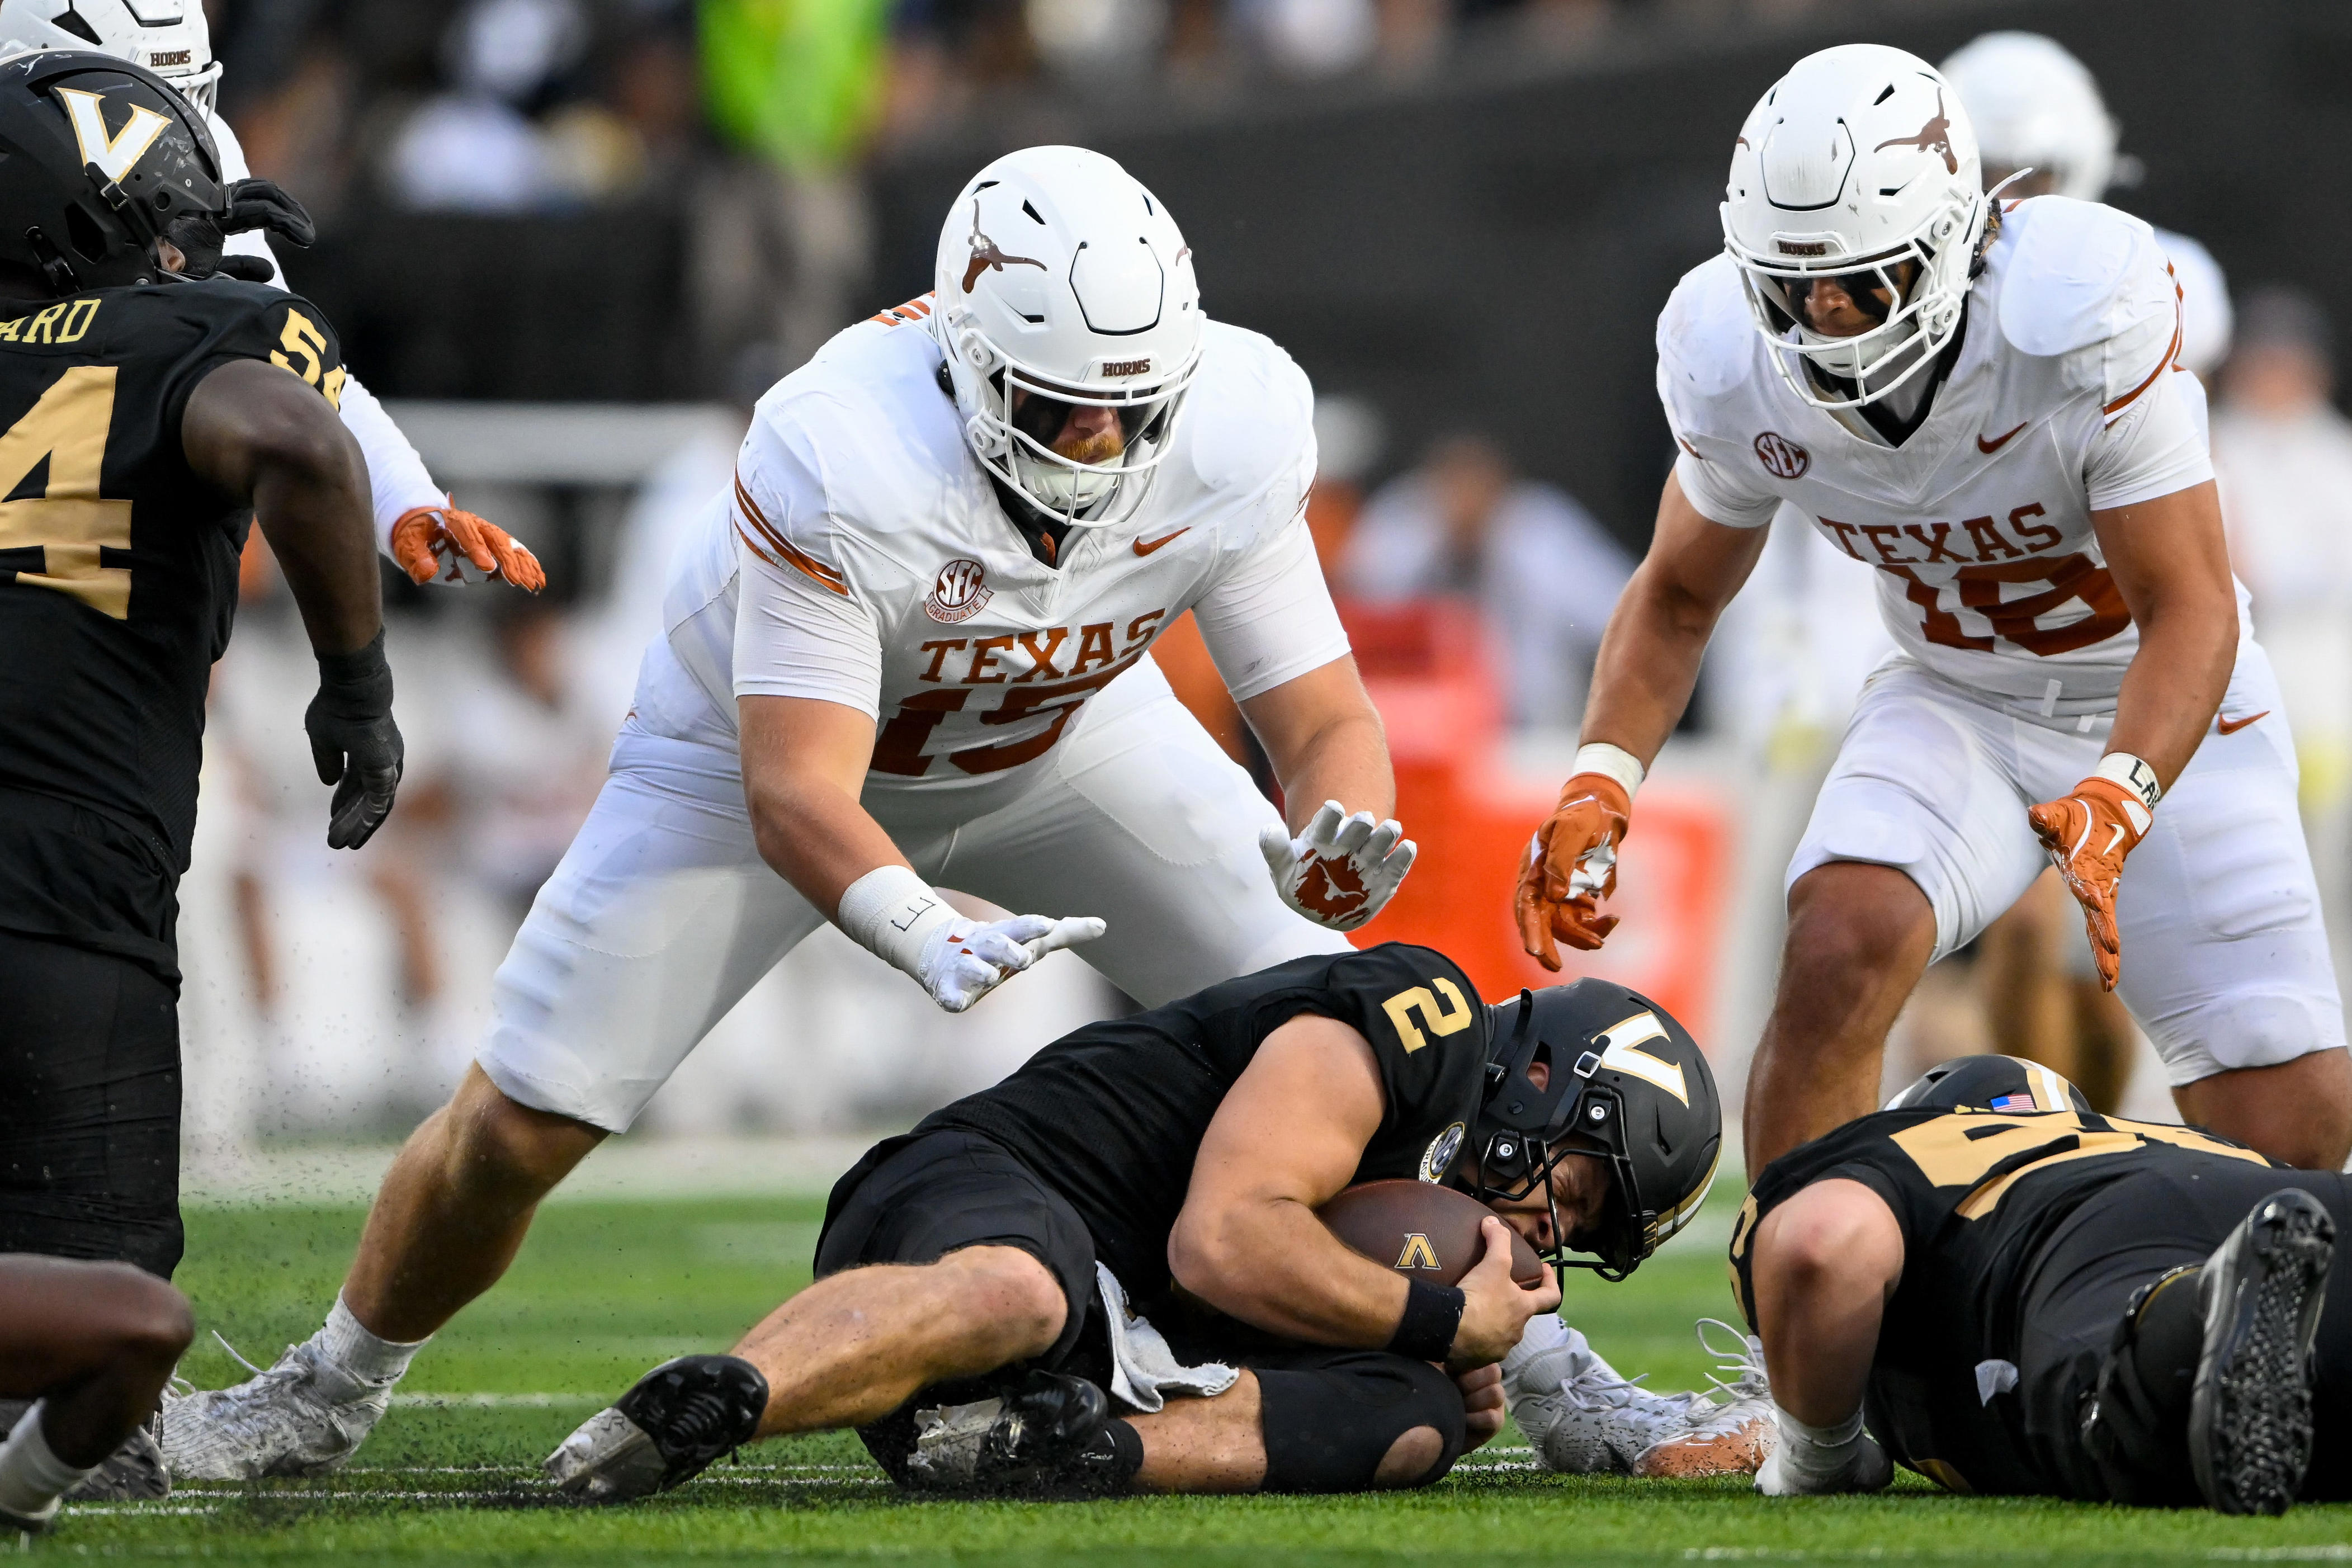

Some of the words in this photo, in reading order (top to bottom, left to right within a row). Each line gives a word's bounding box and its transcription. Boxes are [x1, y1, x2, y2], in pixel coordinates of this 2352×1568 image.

[150, 49, 191, 67] HORNS
[54, 87, 173, 185] V
[1777, 240, 1826, 255] HORNS
[1102, 358, 1150, 377] HORNS
[1757, 434, 1805, 475] SEC
[1817, 502, 2063, 564] TEXAS
[938, 561, 982, 605] SEC
[1876, 552, 2132, 657] 18
[929, 599, 982, 622] GRADUATE
[919, 608, 1166, 684] TEXAS
[868, 651, 1142, 776] 15
[1381, 977, 1473, 1055] 2
[1590, 1009, 1689, 1110] V
[1394, 1233, 1442, 1270] V
